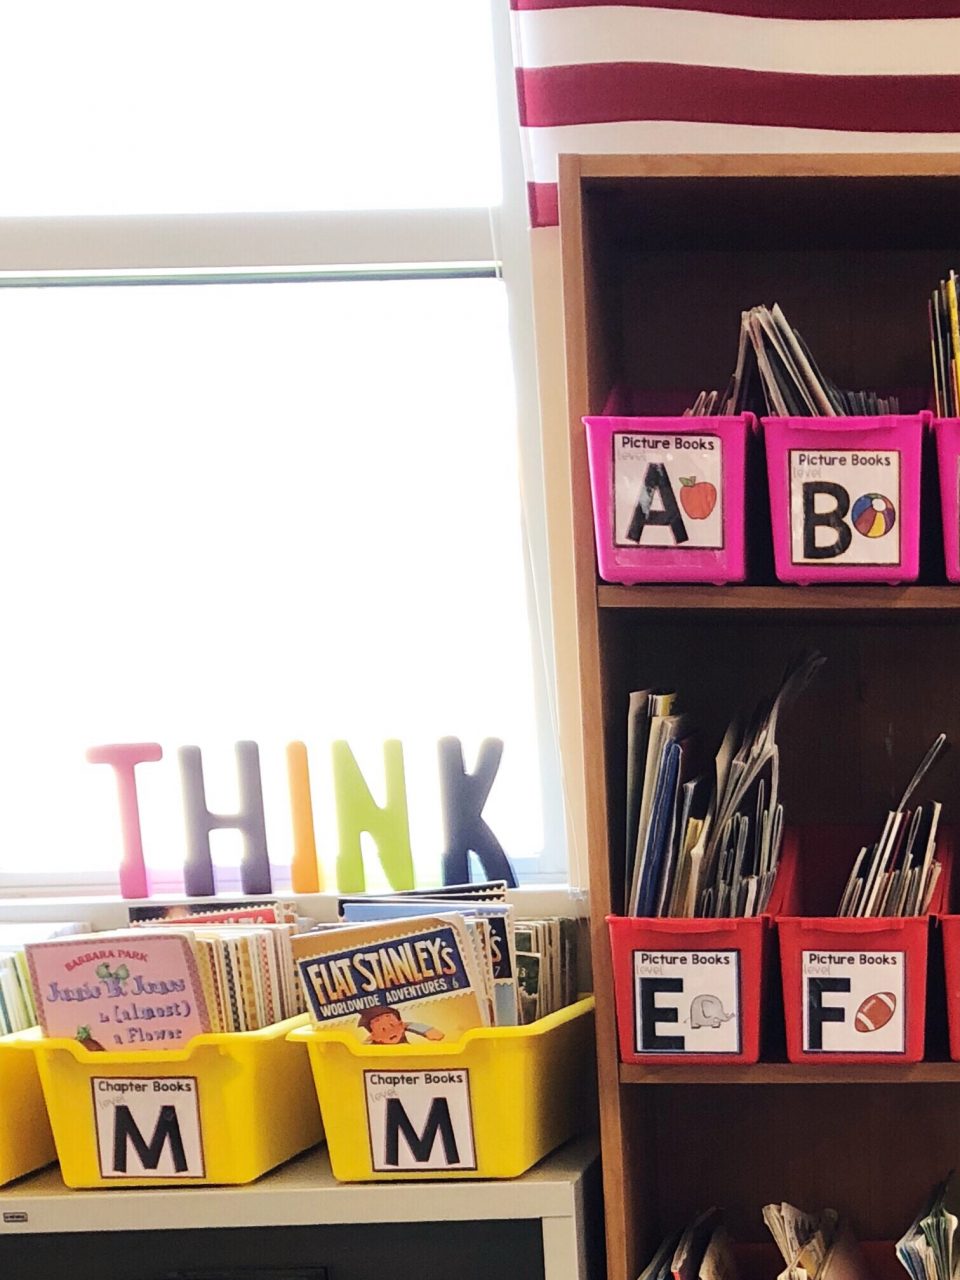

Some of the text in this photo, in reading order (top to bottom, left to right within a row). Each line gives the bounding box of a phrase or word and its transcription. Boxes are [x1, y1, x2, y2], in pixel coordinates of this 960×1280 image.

[621, 436, 715, 451] Picture Books
[798, 453, 891, 467] Picture Books
[625, 462, 689, 544] A
[802, 481, 852, 560] B
[86, 736, 518, 898] THINK
[118, 950, 149, 962] PARK
[306, 958, 358, 1005] FLAT
[353, 937, 457, 993] STANLEY'S
[640, 953, 731, 966] Picture Books
[809, 953, 897, 966] Picture Books
[319, 994, 381, 1018] WORLDWIDE
[386, 978, 448, 1005] ADVENTURES
[640, 977, 685, 1051] E
[808, 977, 851, 1050] F
[128, 1027, 182, 1044] Flower
[98, 1080, 192, 1094] Chapter Books
[369, 1071, 464, 1087] Chapter Books
[112, 1104, 189, 1173] M
[384, 1097, 460, 1167] M
